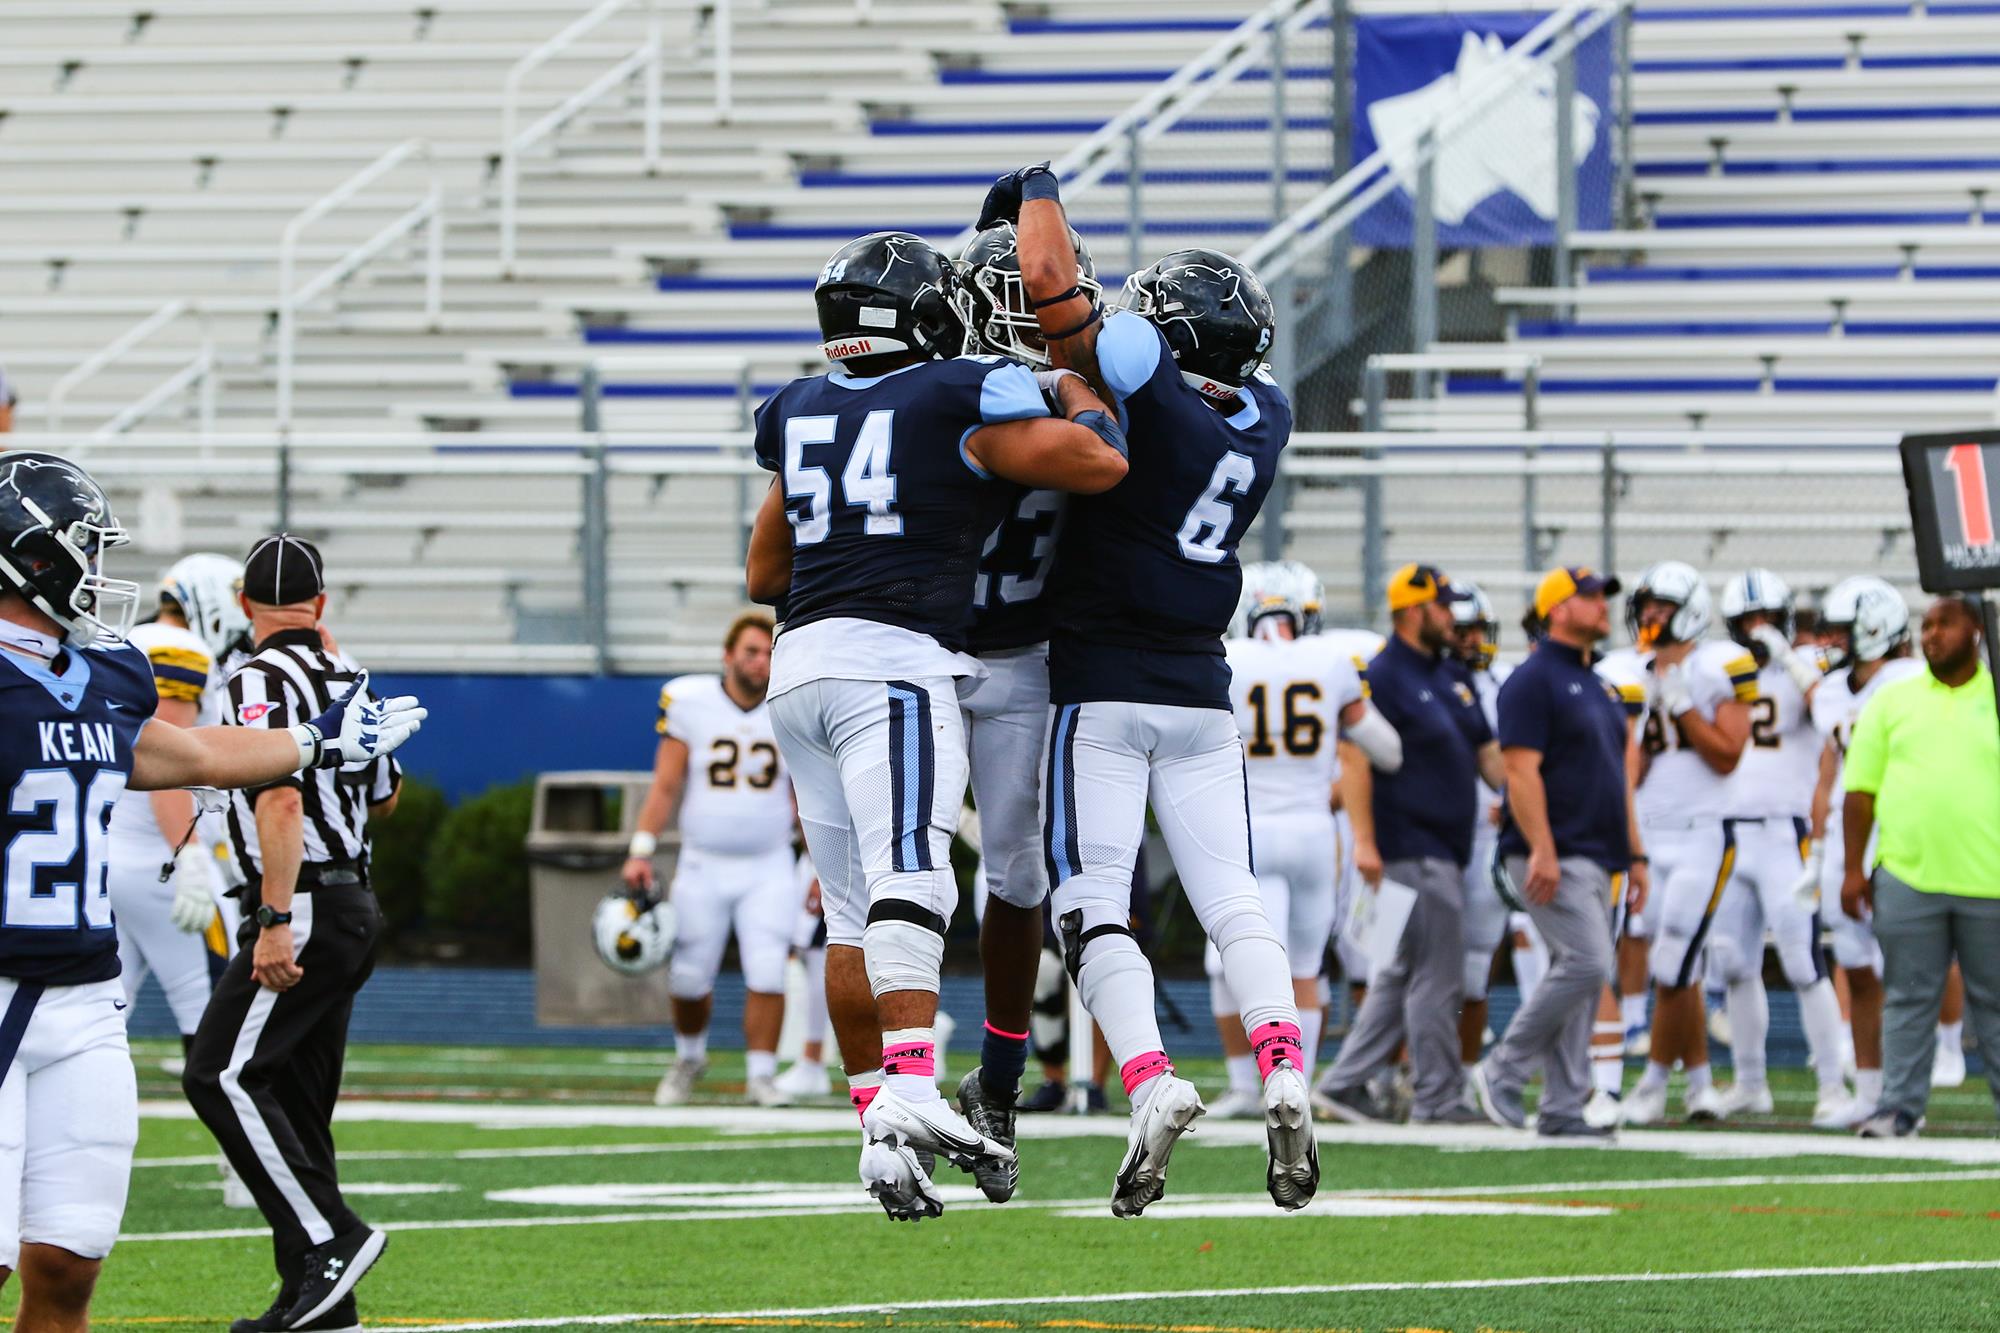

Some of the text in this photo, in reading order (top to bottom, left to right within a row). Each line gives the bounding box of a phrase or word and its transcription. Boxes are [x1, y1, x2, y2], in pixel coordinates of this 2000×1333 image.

[825, 340, 872, 360] Riddell
[1255, 327, 1271, 353] 6
[783, 409, 905, 546] 54
[1175, 450, 1257, 565] 6
[1942, 443, 1995, 546] 1
[38, 720, 117, 763] KEAN
[1247, 681, 1324, 758] 16
[707, 738, 780, 790] 23
